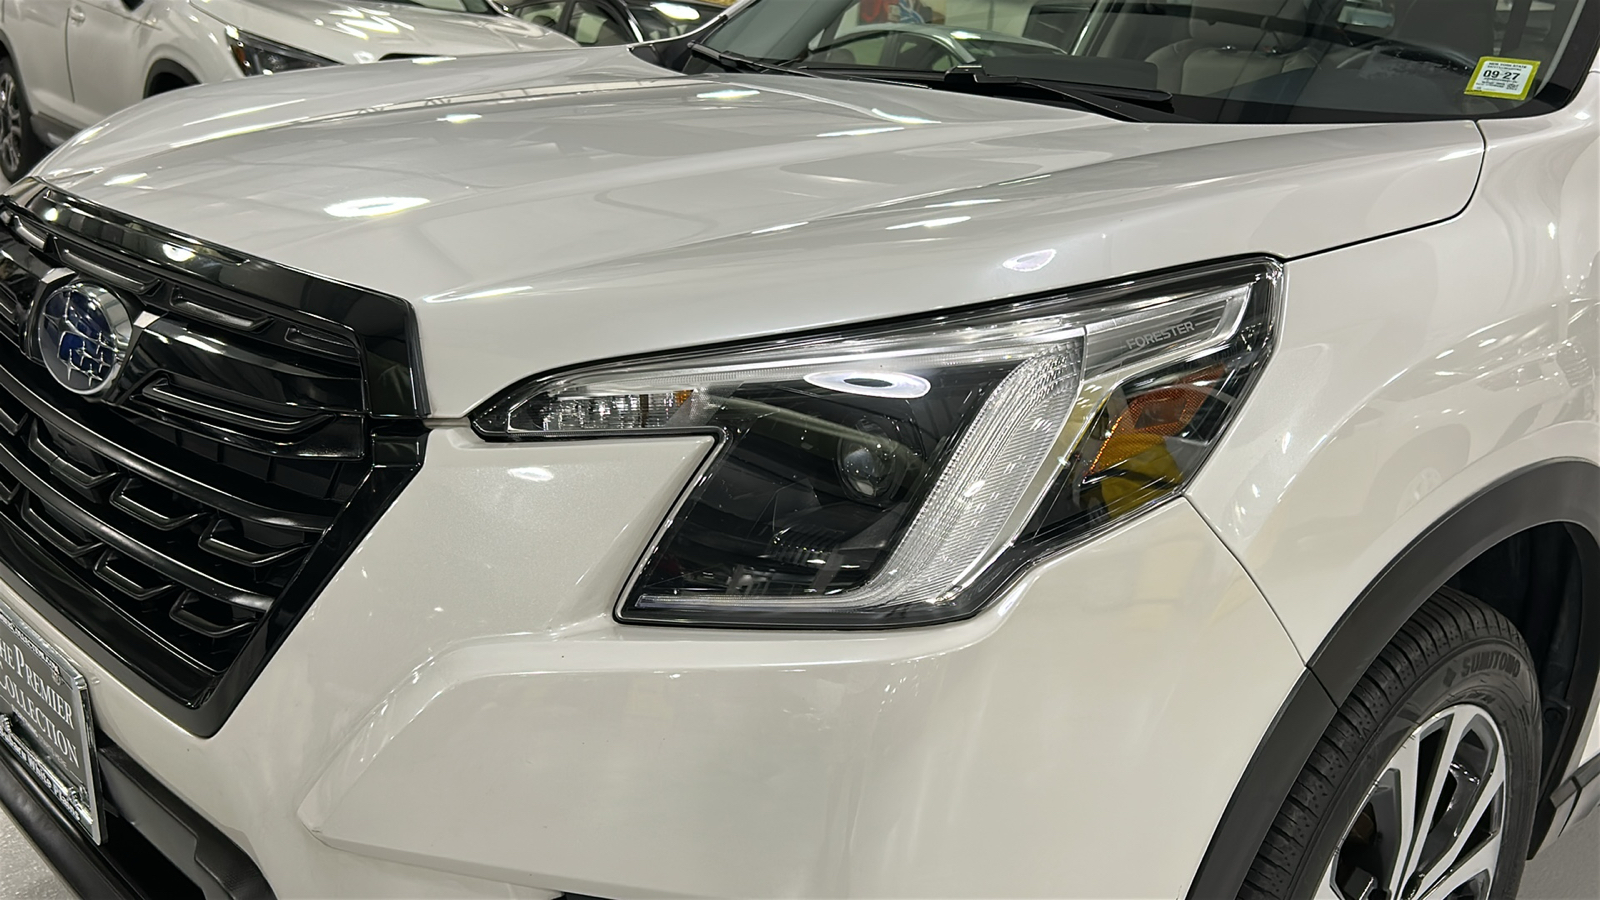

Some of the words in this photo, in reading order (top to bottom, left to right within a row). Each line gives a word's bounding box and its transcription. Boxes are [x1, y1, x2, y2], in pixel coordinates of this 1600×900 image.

[1483, 70, 1500, 78] 09
[1503, 72, 1520, 80] 27
[1125, 321, 1195, 350] FORESTER
[1460, 650, 1521, 678] SUMITOMO
[0, 638, 15, 670] HE
[13, 643, 75, 731] PREMIER
